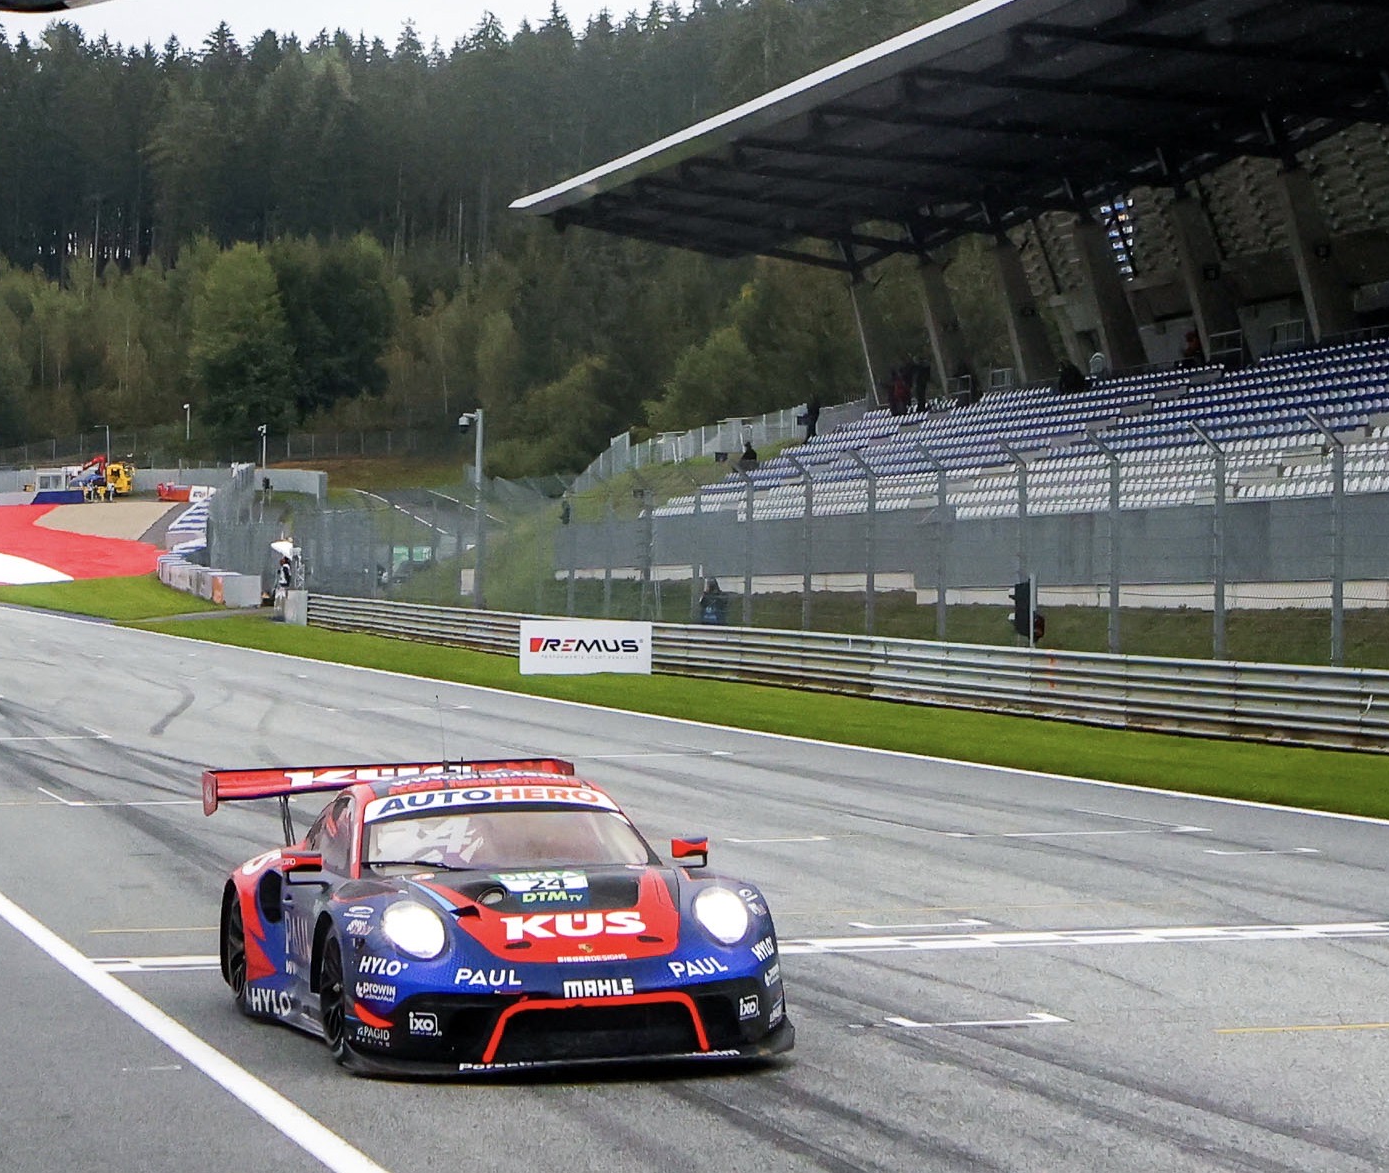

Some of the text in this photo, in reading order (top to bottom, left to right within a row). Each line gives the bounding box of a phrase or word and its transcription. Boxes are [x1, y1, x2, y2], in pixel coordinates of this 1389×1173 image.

[542, 639, 639, 653] REMUS
[377, 787, 599, 816] AUTOHERO
[523, 891, 583, 903] DTM TV
[500, 911, 647, 940] KÜS
[454, 968, 522, 986] PAUL
[668, 957, 729, 978] PAUL
[563, 978, 634, 999] MAHLE
[251, 988, 292, 1017] HYLO
[364, 1025, 390, 1041] PAGID
